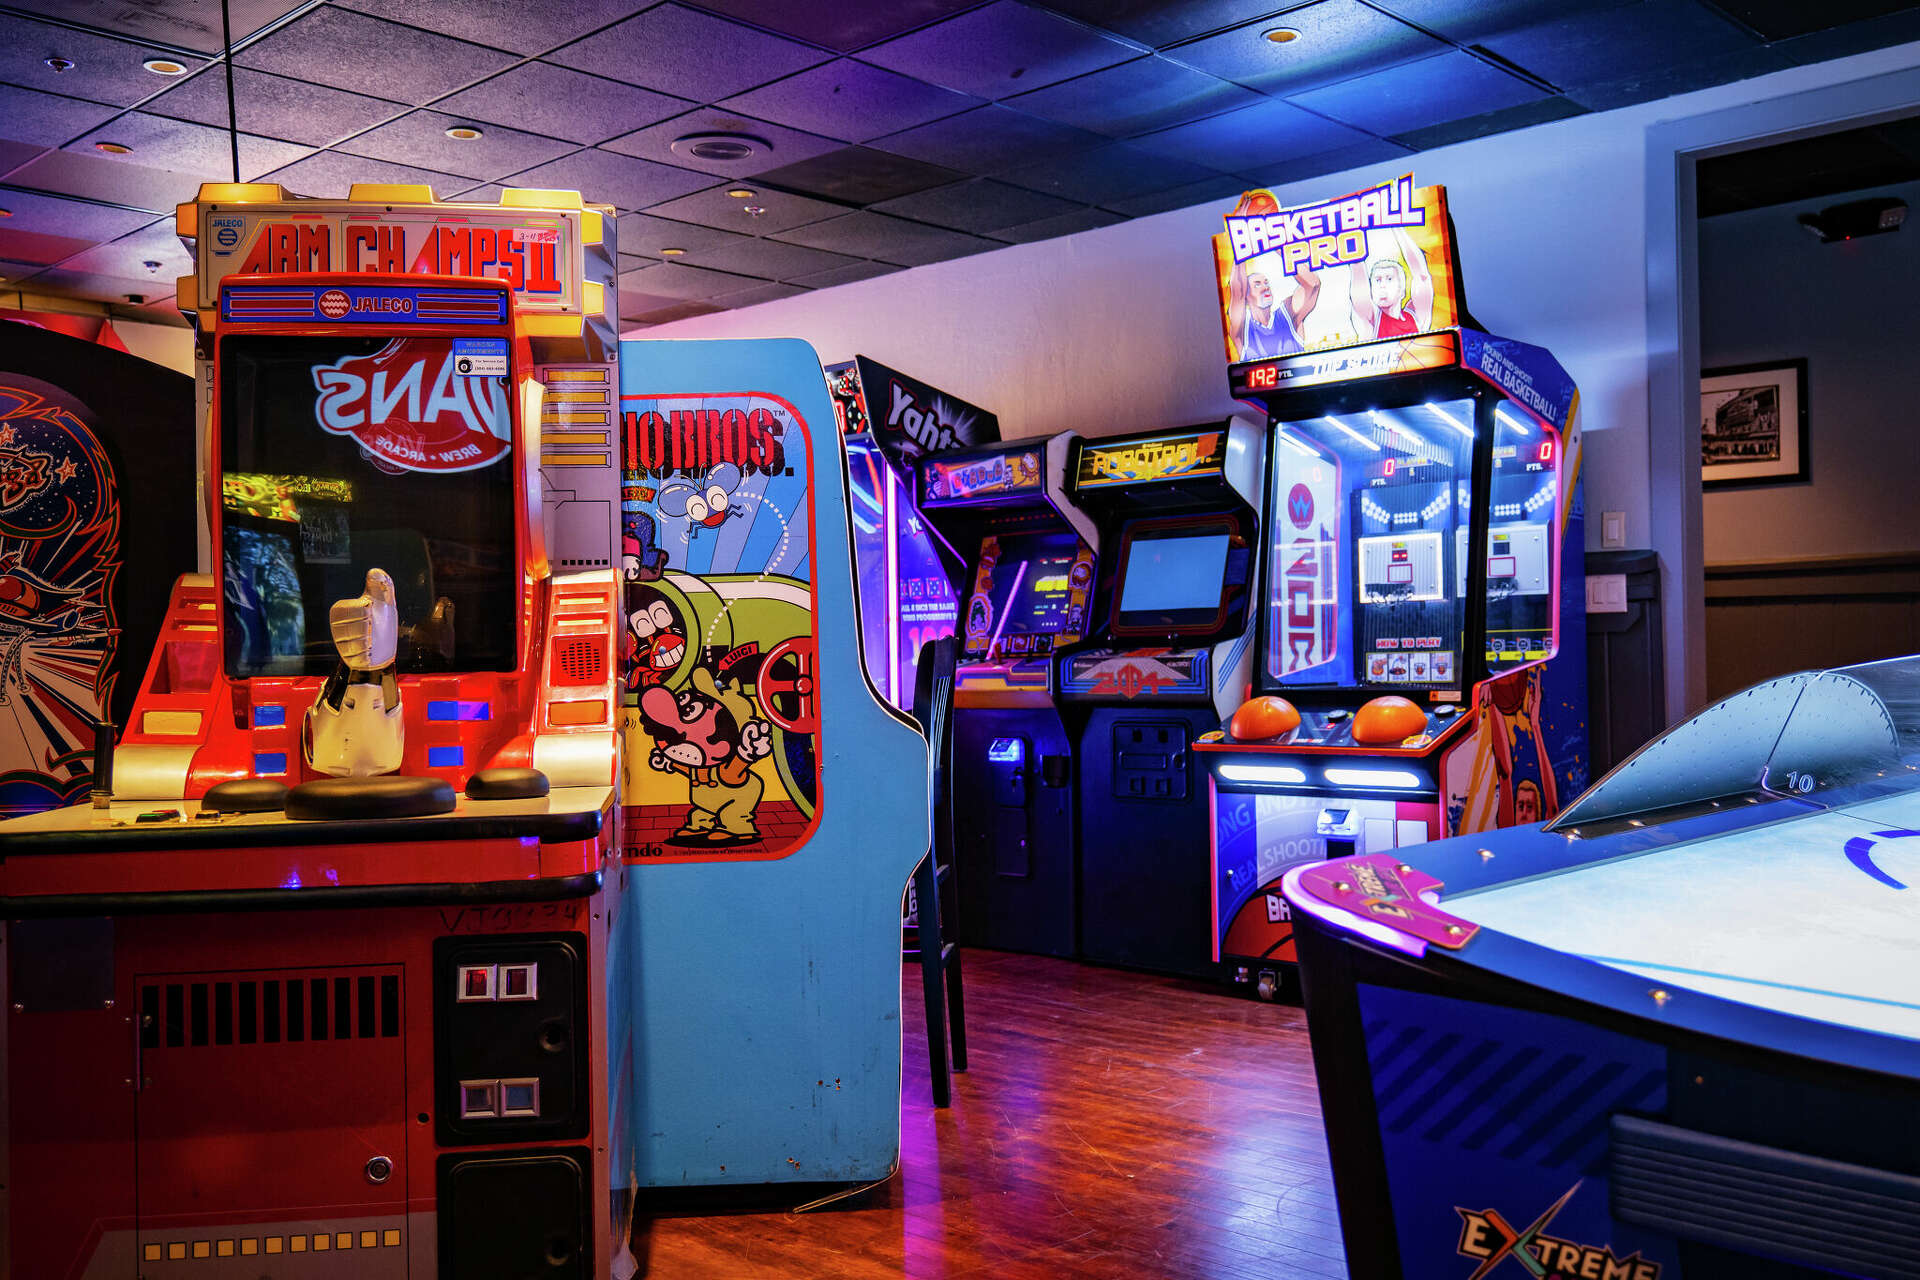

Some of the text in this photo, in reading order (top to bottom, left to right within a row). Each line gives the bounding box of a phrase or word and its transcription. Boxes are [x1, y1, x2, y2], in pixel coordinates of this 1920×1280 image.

[212, 219, 243, 228] JALECO
[1228, 177, 1424, 263] BASKETBALL
[238, 223, 331, 274] ARM
[1282, 230, 1367, 275] PRO
[351, 296, 413, 314] JALECO
[1249, 367, 1277, 388] 192
[1312, 359, 1342, 377] TOP
[1481, 353, 1557, 422] REAL BASKETBALL!
[888, 383, 962, 451] Yaht
[1538, 442, 1552, 460] 0
[1384, 458, 1395, 476] 0
[1376, 637, 1442, 649] HOW TO PLAY
[1786, 771, 1814, 793] 10
[1264, 837, 1326, 869] SHOOTI
